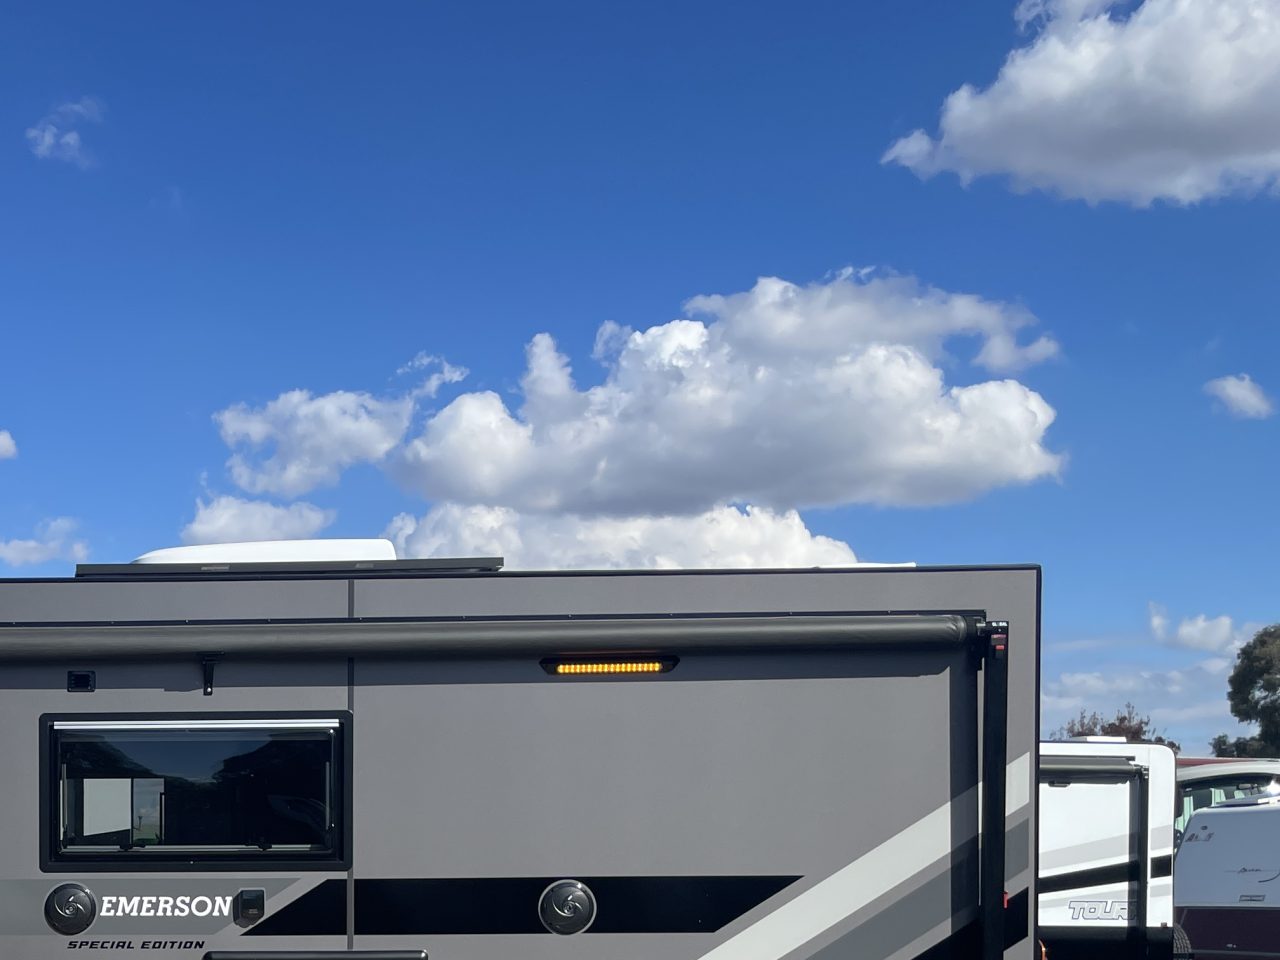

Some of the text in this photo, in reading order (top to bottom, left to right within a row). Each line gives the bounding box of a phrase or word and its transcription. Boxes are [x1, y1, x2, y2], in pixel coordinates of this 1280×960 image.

[100, 896, 232, 917] EMERSON
[67, 941, 205, 950] SPECIAL EDITION
